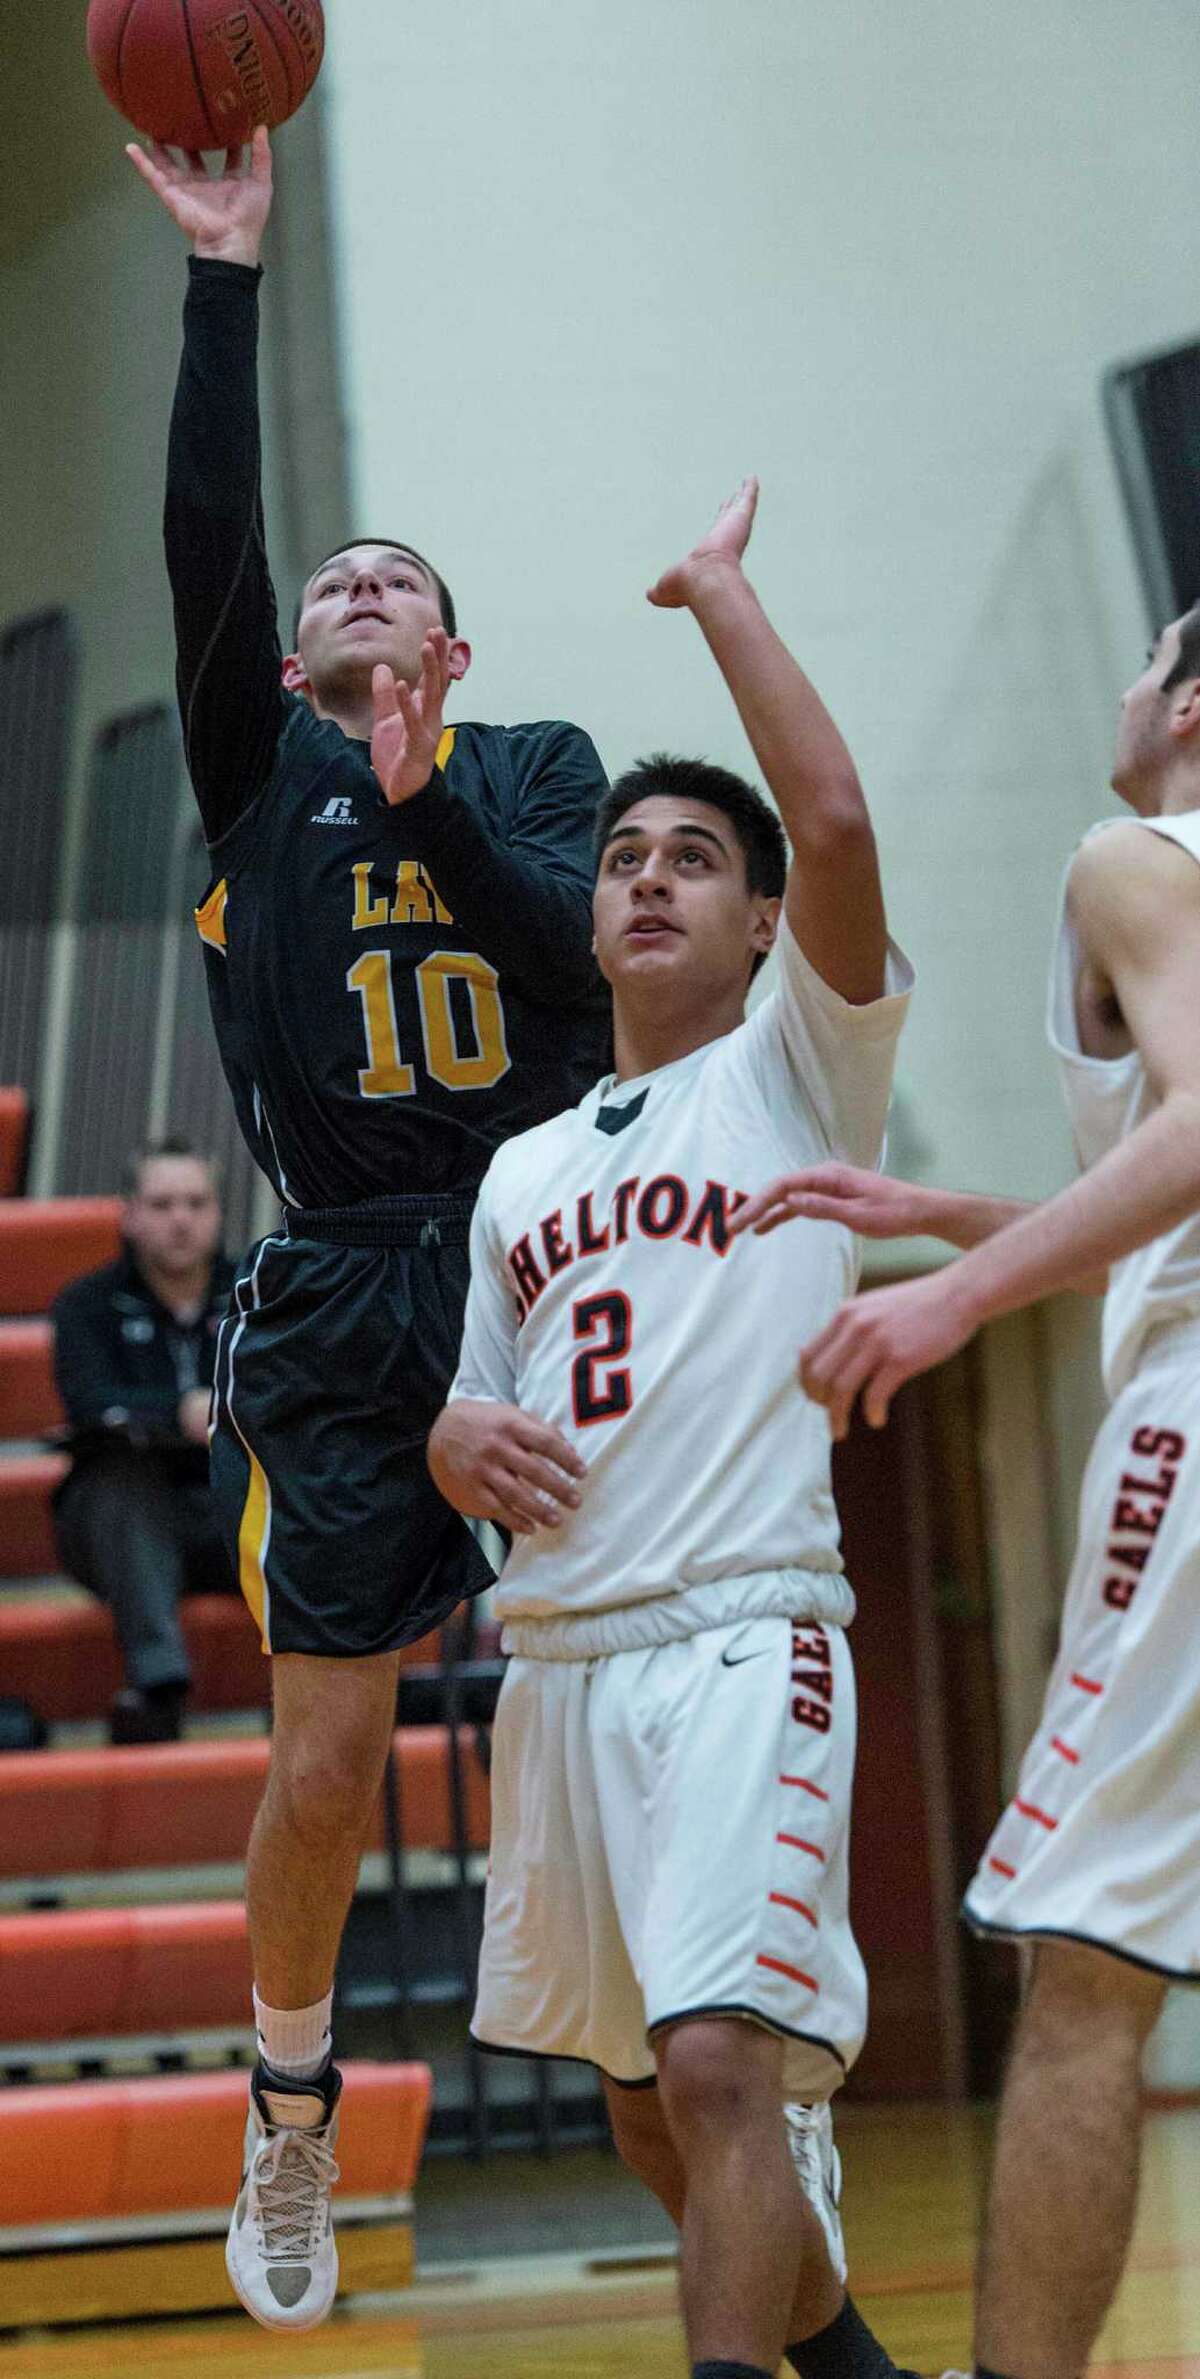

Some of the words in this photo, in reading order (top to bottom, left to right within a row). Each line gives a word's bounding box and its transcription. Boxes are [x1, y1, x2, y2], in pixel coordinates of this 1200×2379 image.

[310, 816, 359, 825] RUSSELL
[346, 949, 512, 1098] 10
[505, 1174, 750, 1328] HELTON
[573, 1290, 633, 1428] 2
[1102, 1424, 1188, 1613] GAELS
